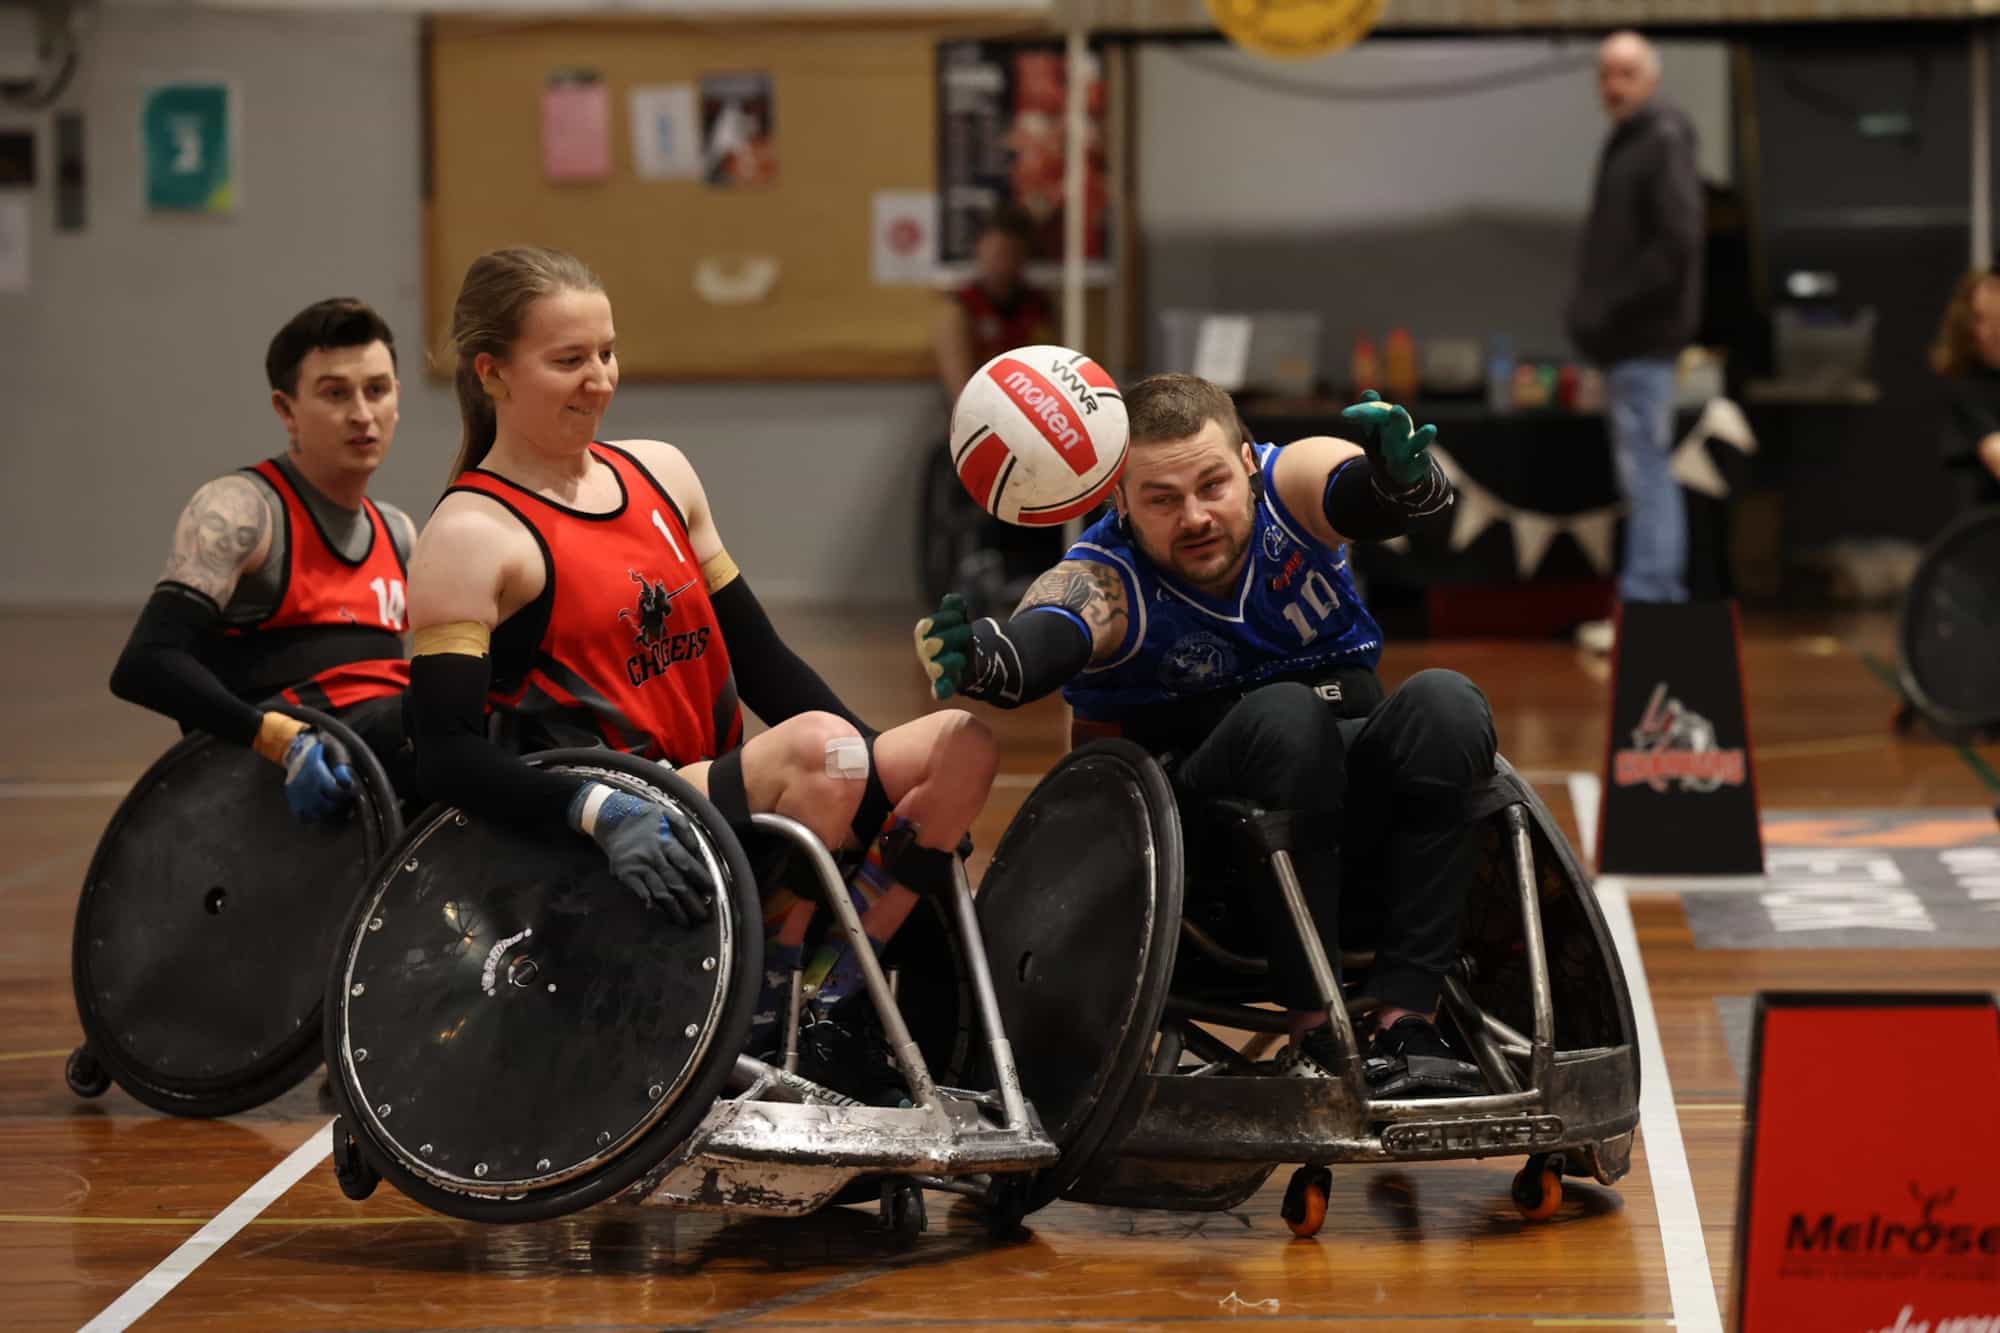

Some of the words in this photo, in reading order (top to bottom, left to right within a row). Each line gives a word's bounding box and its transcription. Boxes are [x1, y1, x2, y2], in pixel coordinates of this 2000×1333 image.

[1003, 370, 1081, 449] molten
[652, 508, 686, 563] 1
[370, 577, 405, 631] 14
[1282, 568, 1340, 647] 10
[626, 626, 711, 688] CHGERS
[1785, 1213, 2000, 1256] Melrose
